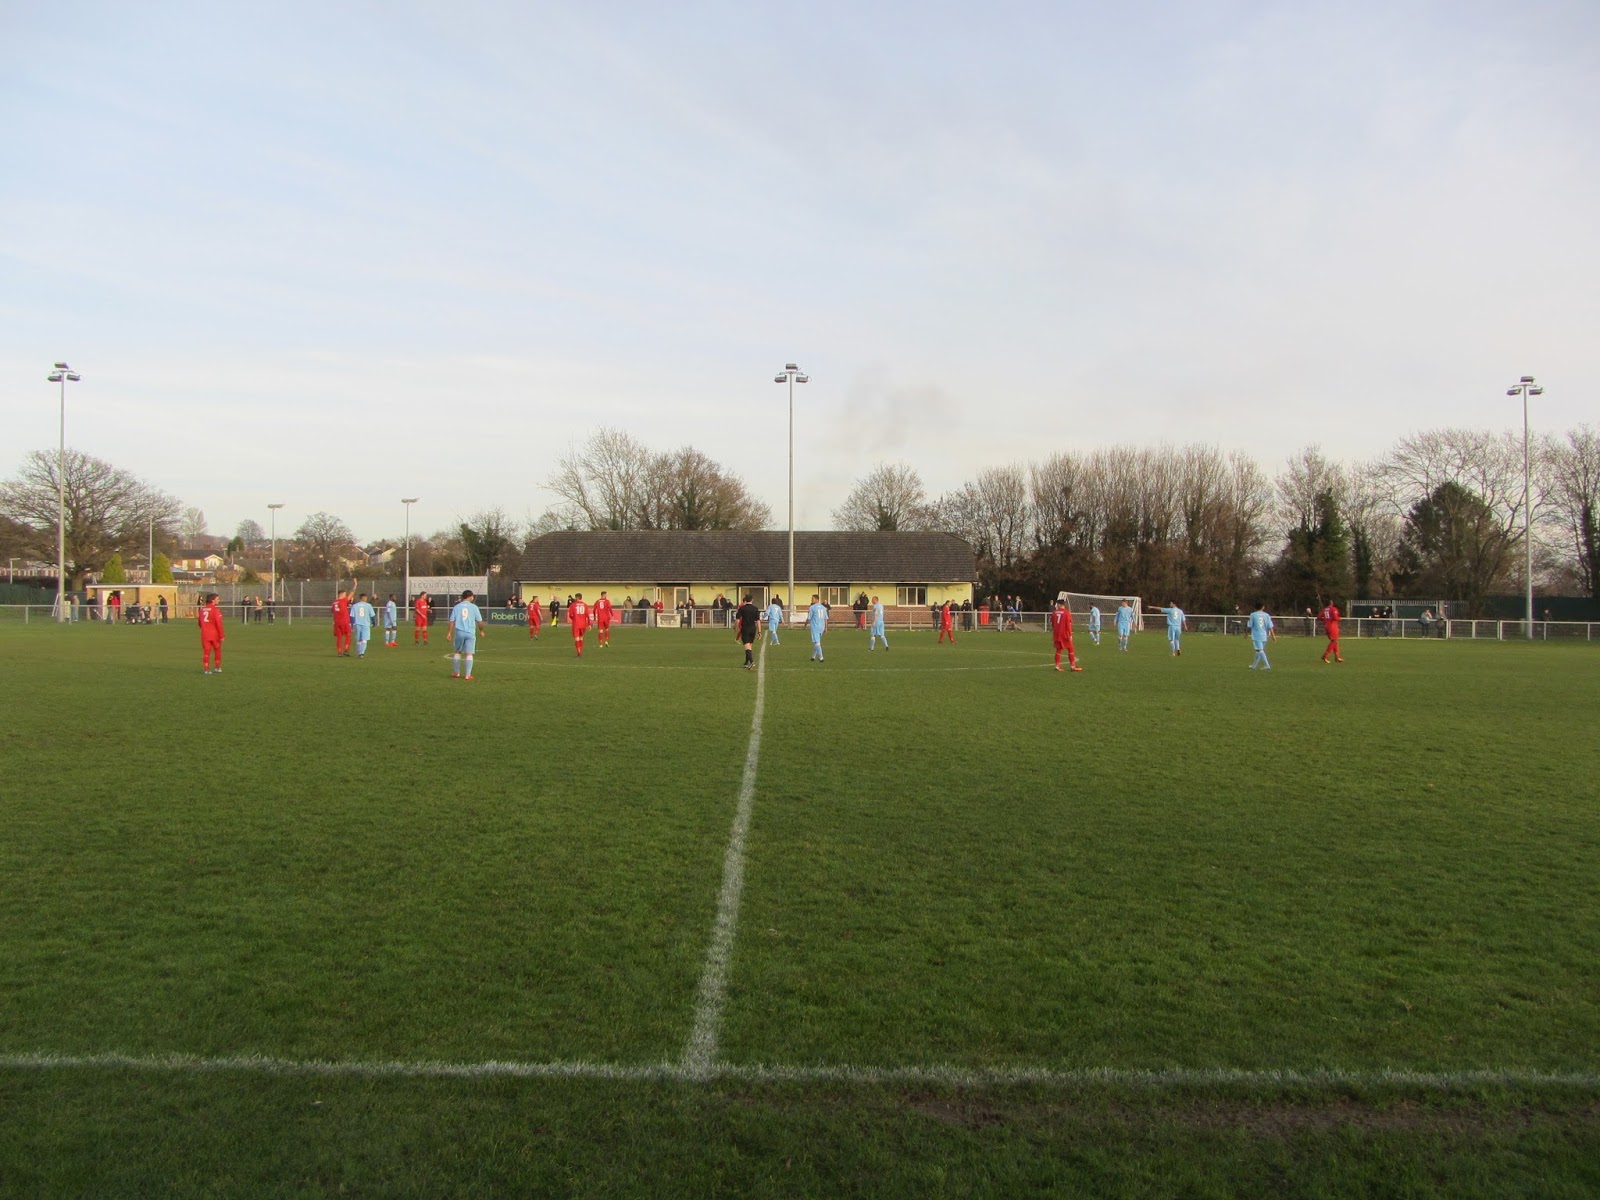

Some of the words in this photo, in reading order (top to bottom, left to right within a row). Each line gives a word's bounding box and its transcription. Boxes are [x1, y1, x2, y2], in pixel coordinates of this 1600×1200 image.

[359, 607, 365, 617] 8
[462, 607, 469, 621] 9
[575, 605, 585, 615] 10
[817, 609, 824, 619] 11
[203, 611, 210, 622] 2
[491, 612, 517, 620] Robert
[1056, 613, 1062, 624] 7
